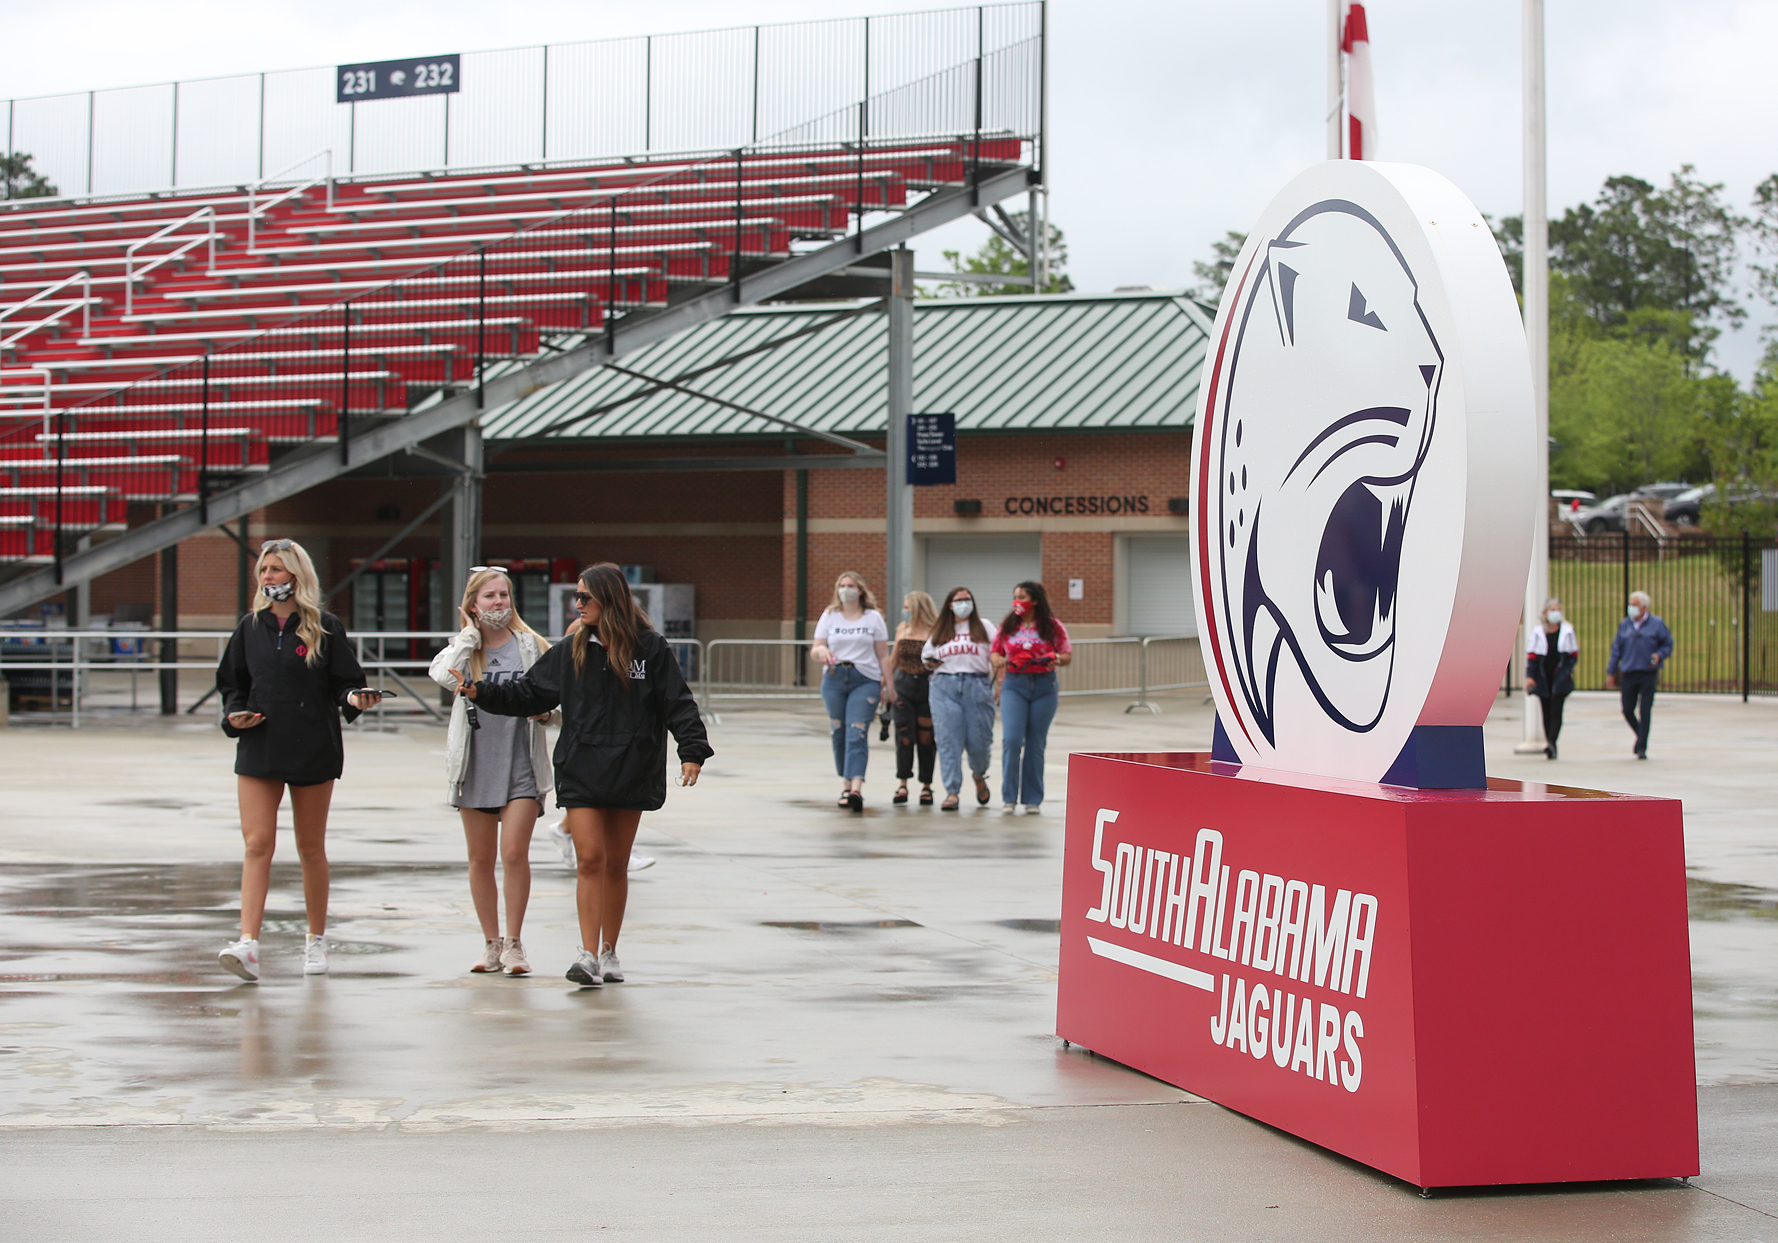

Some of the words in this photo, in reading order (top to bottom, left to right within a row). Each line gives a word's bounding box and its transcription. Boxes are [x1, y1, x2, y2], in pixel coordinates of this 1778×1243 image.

[342, 69, 376, 95] 231
[414, 62, 454, 89] 232
[1005, 495, 1150, 515] CONCESSIONS
[834, 627, 870, 636] SOUTH
[1210, 973, 1364, 1093] JAGUARS
